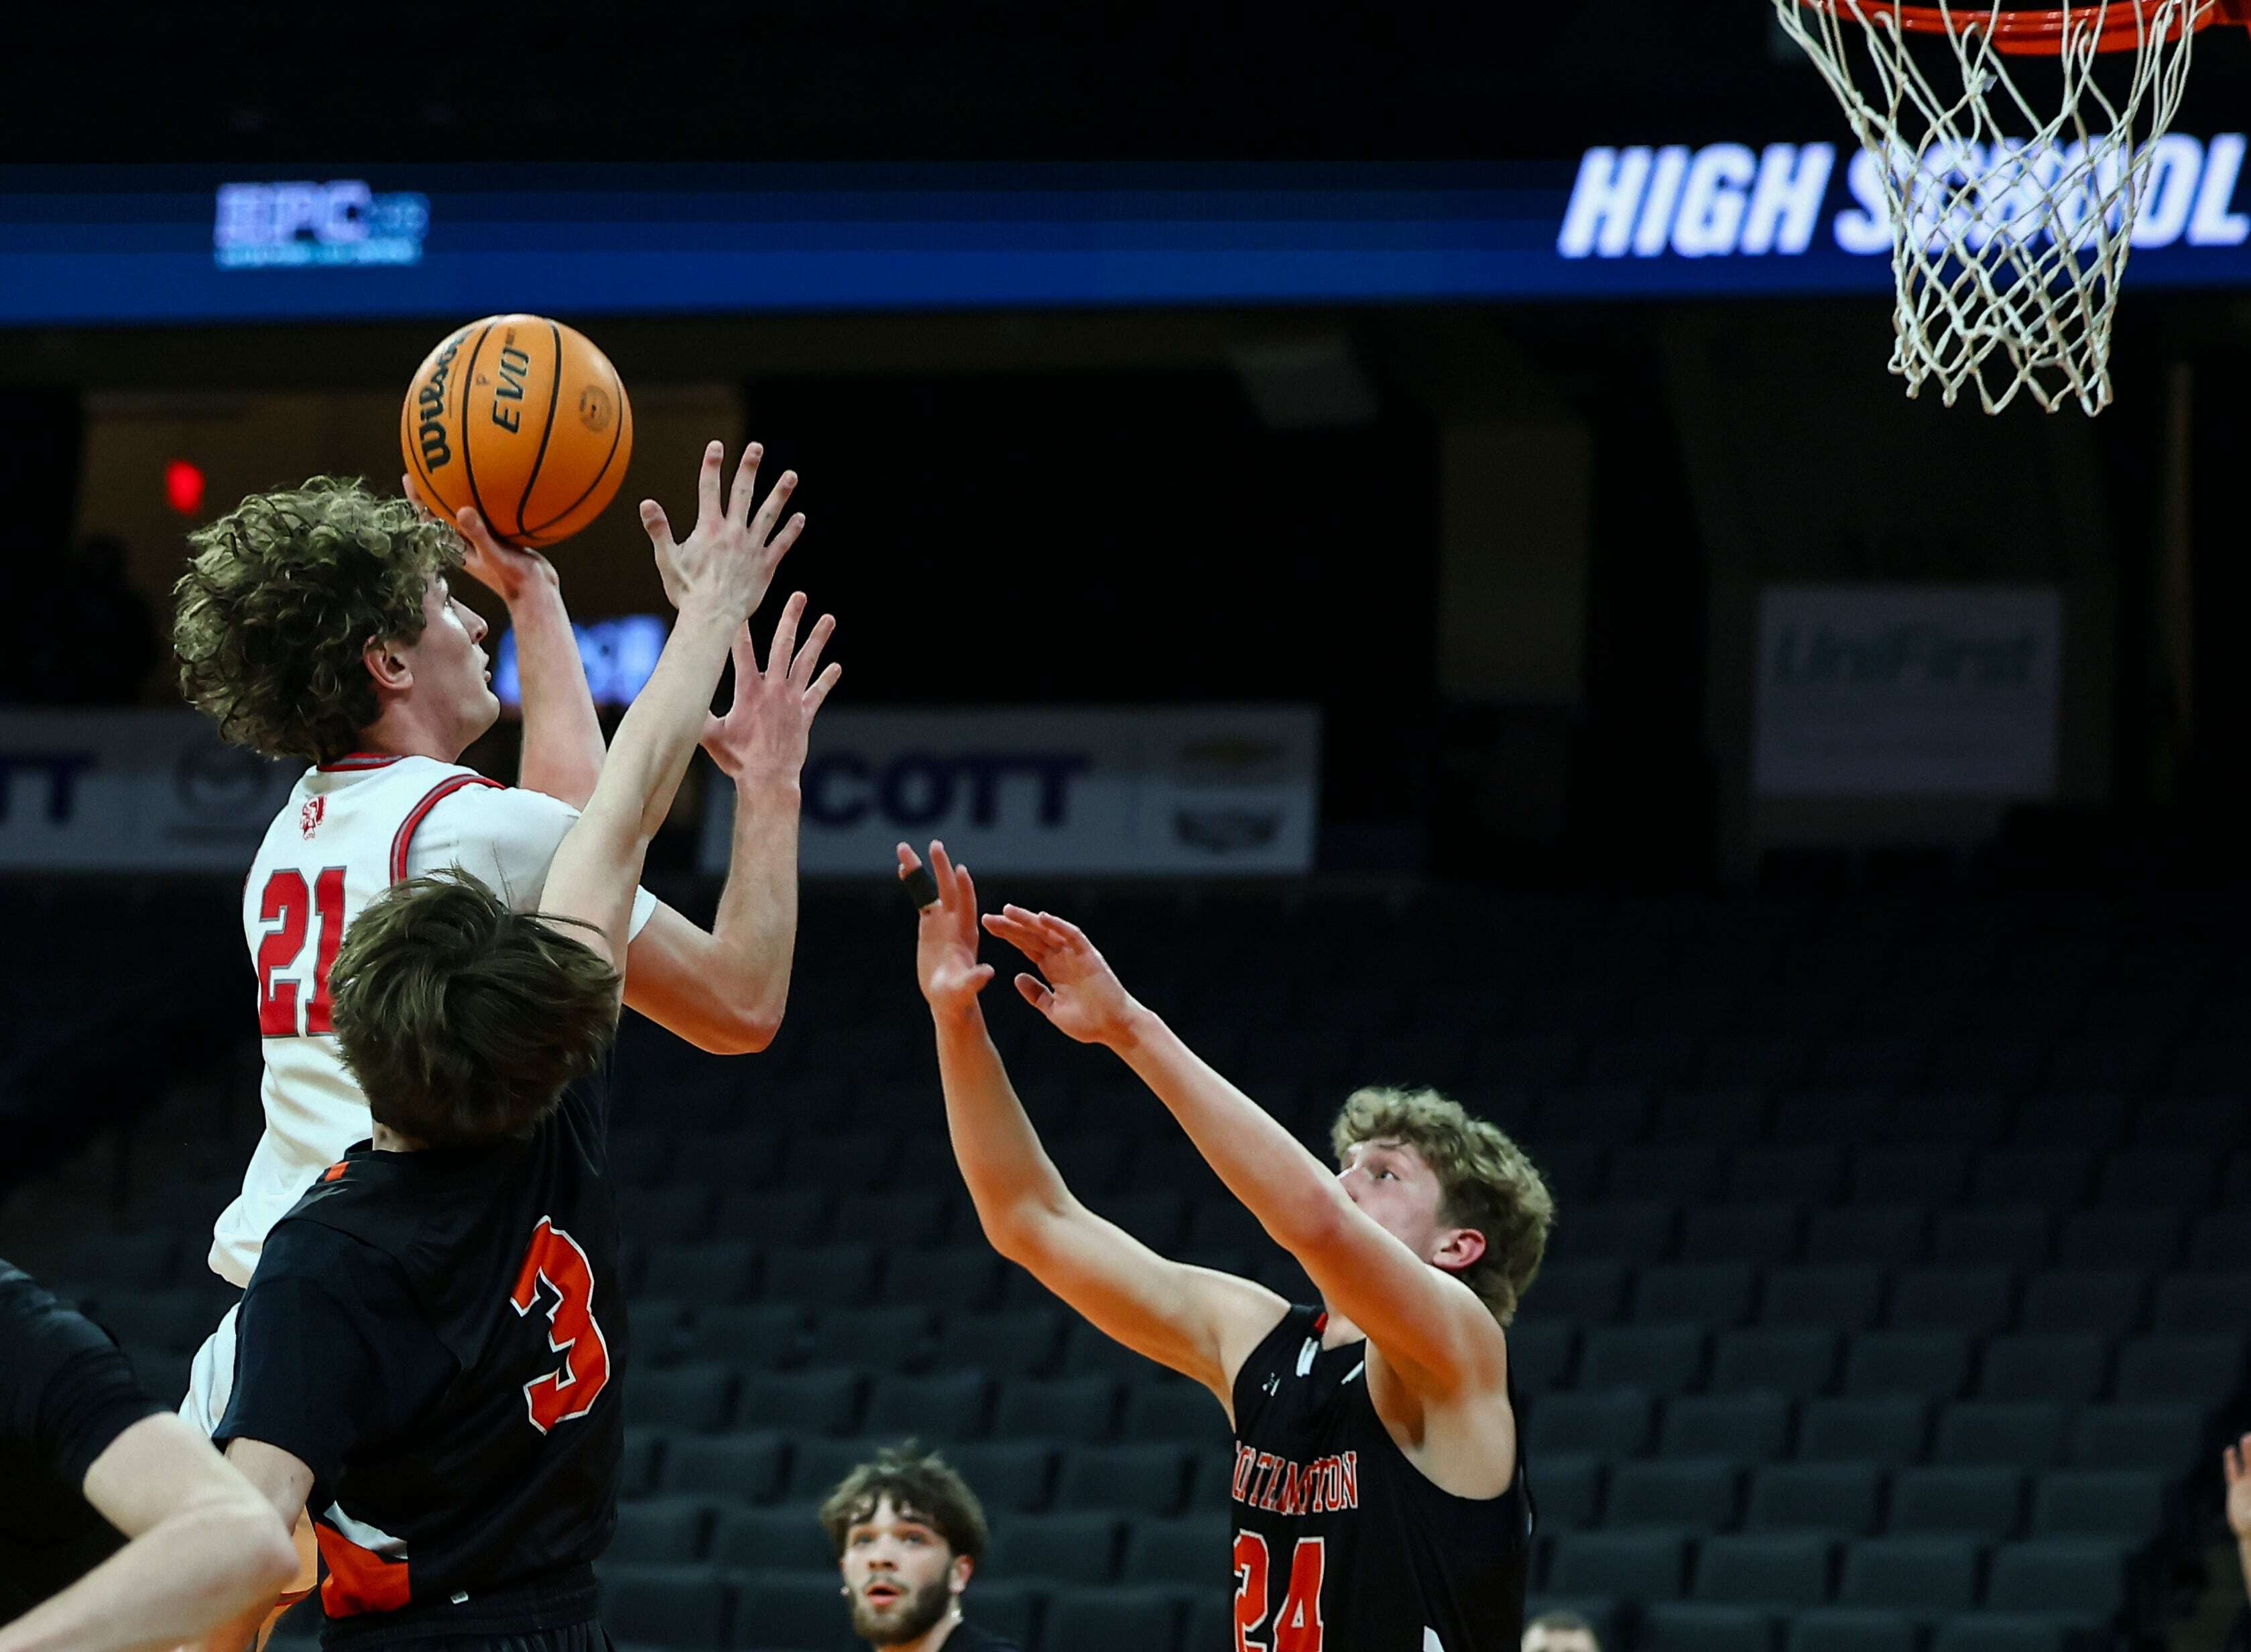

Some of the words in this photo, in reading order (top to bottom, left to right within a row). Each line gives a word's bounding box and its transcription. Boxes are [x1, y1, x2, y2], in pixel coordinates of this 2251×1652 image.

[1557, 140, 1837, 259] HIGH
[1833, 132, 2250, 255] SCHOOL
[492, 344, 531, 434] EVO
[803, 751, 1090, 827] COTT
[259, 866, 347, 1037] 21
[509, 1214, 611, 1436] 3
[1233, 1527, 1325, 1652] 24
